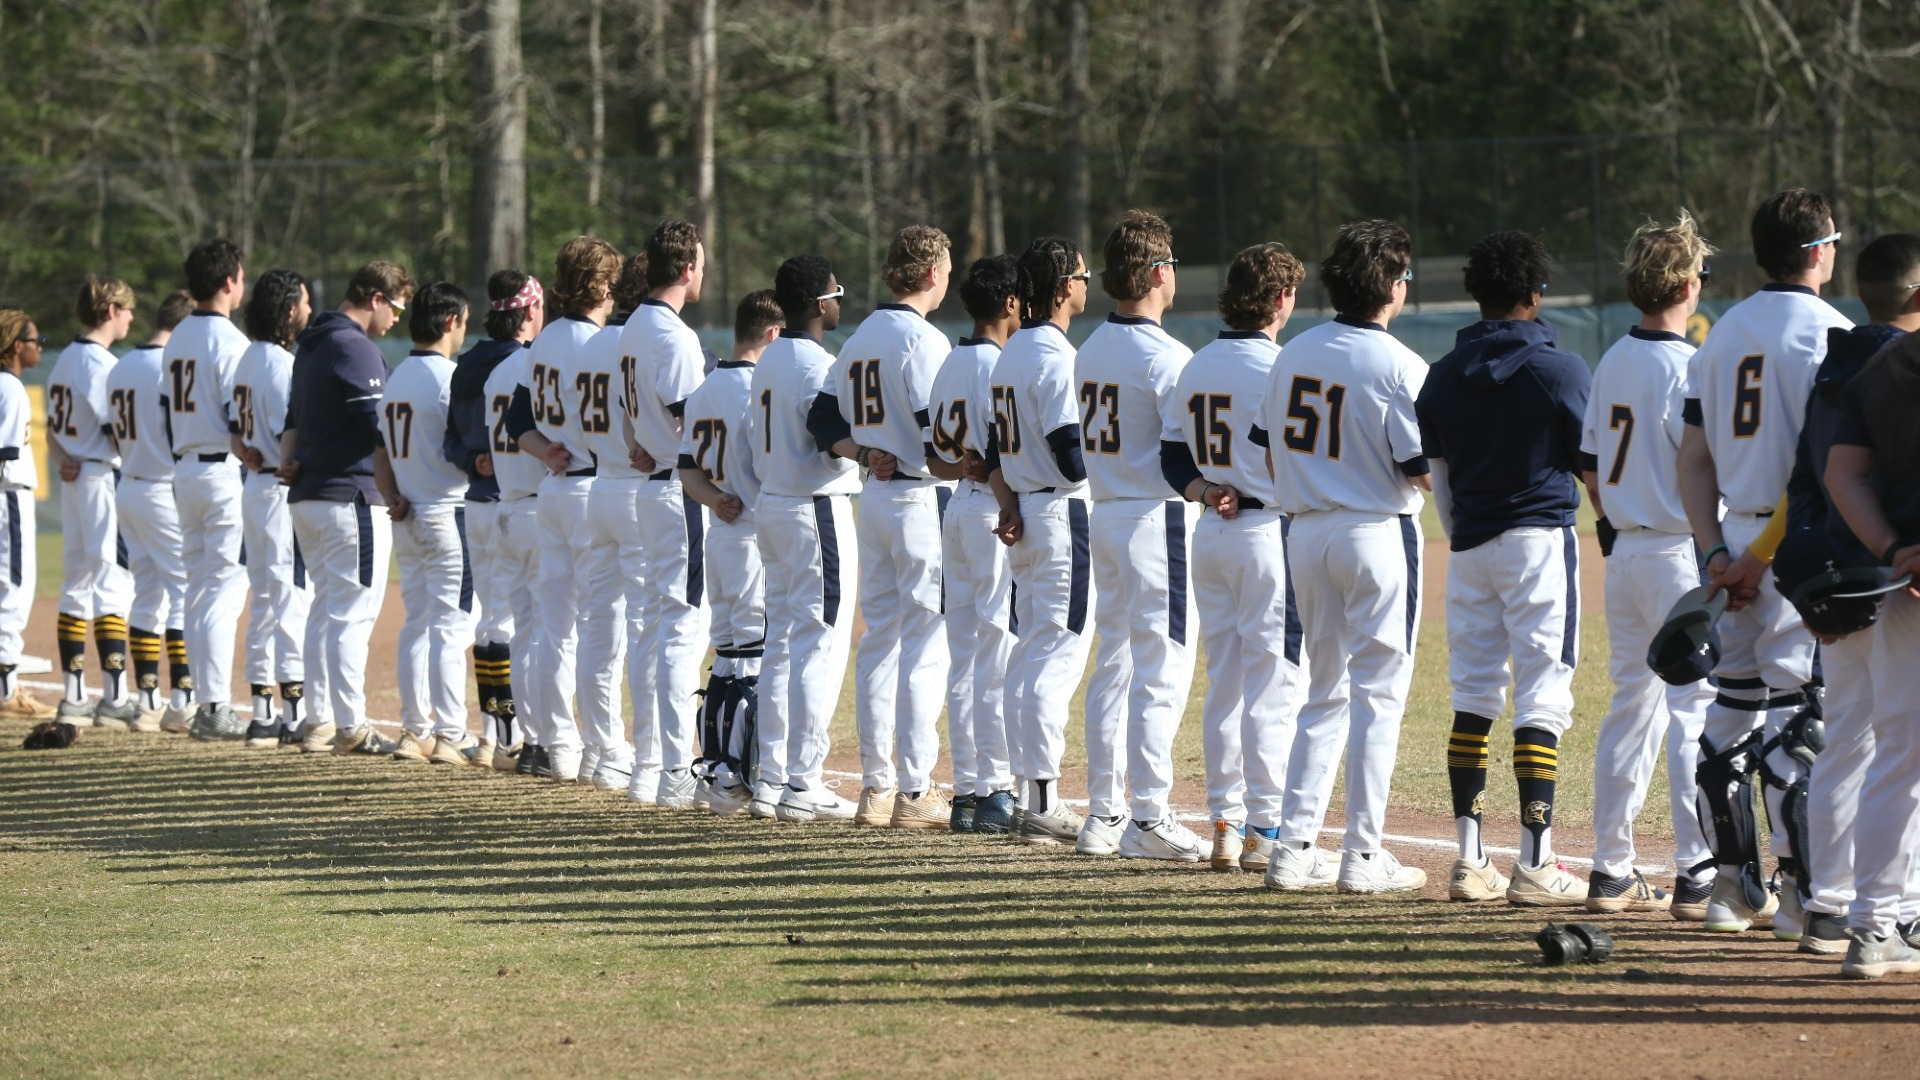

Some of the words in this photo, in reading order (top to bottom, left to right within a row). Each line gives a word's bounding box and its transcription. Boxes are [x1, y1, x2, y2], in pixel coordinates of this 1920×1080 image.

[51, 384, 77, 436] 32
[111, 389, 136, 440] 31
[170, 358, 195, 413] 12
[533, 363, 566, 427] 33
[576, 371, 610, 434] 29
[848, 358, 885, 427] 19
[1080, 381, 1121, 455] 23
[1284, 374, 1346, 461] 51
[1732, 354, 1765, 439] 6
[385, 401, 413, 459] 17
[492, 393, 519, 453] 2
[692, 418, 727, 483] 27
[761, 388, 771, 454] 1
[932, 398, 967, 459] 42
[991, 385, 1021, 455] 50
[1187, 393, 1232, 467] 15
[1607, 403, 1634, 486] 7
